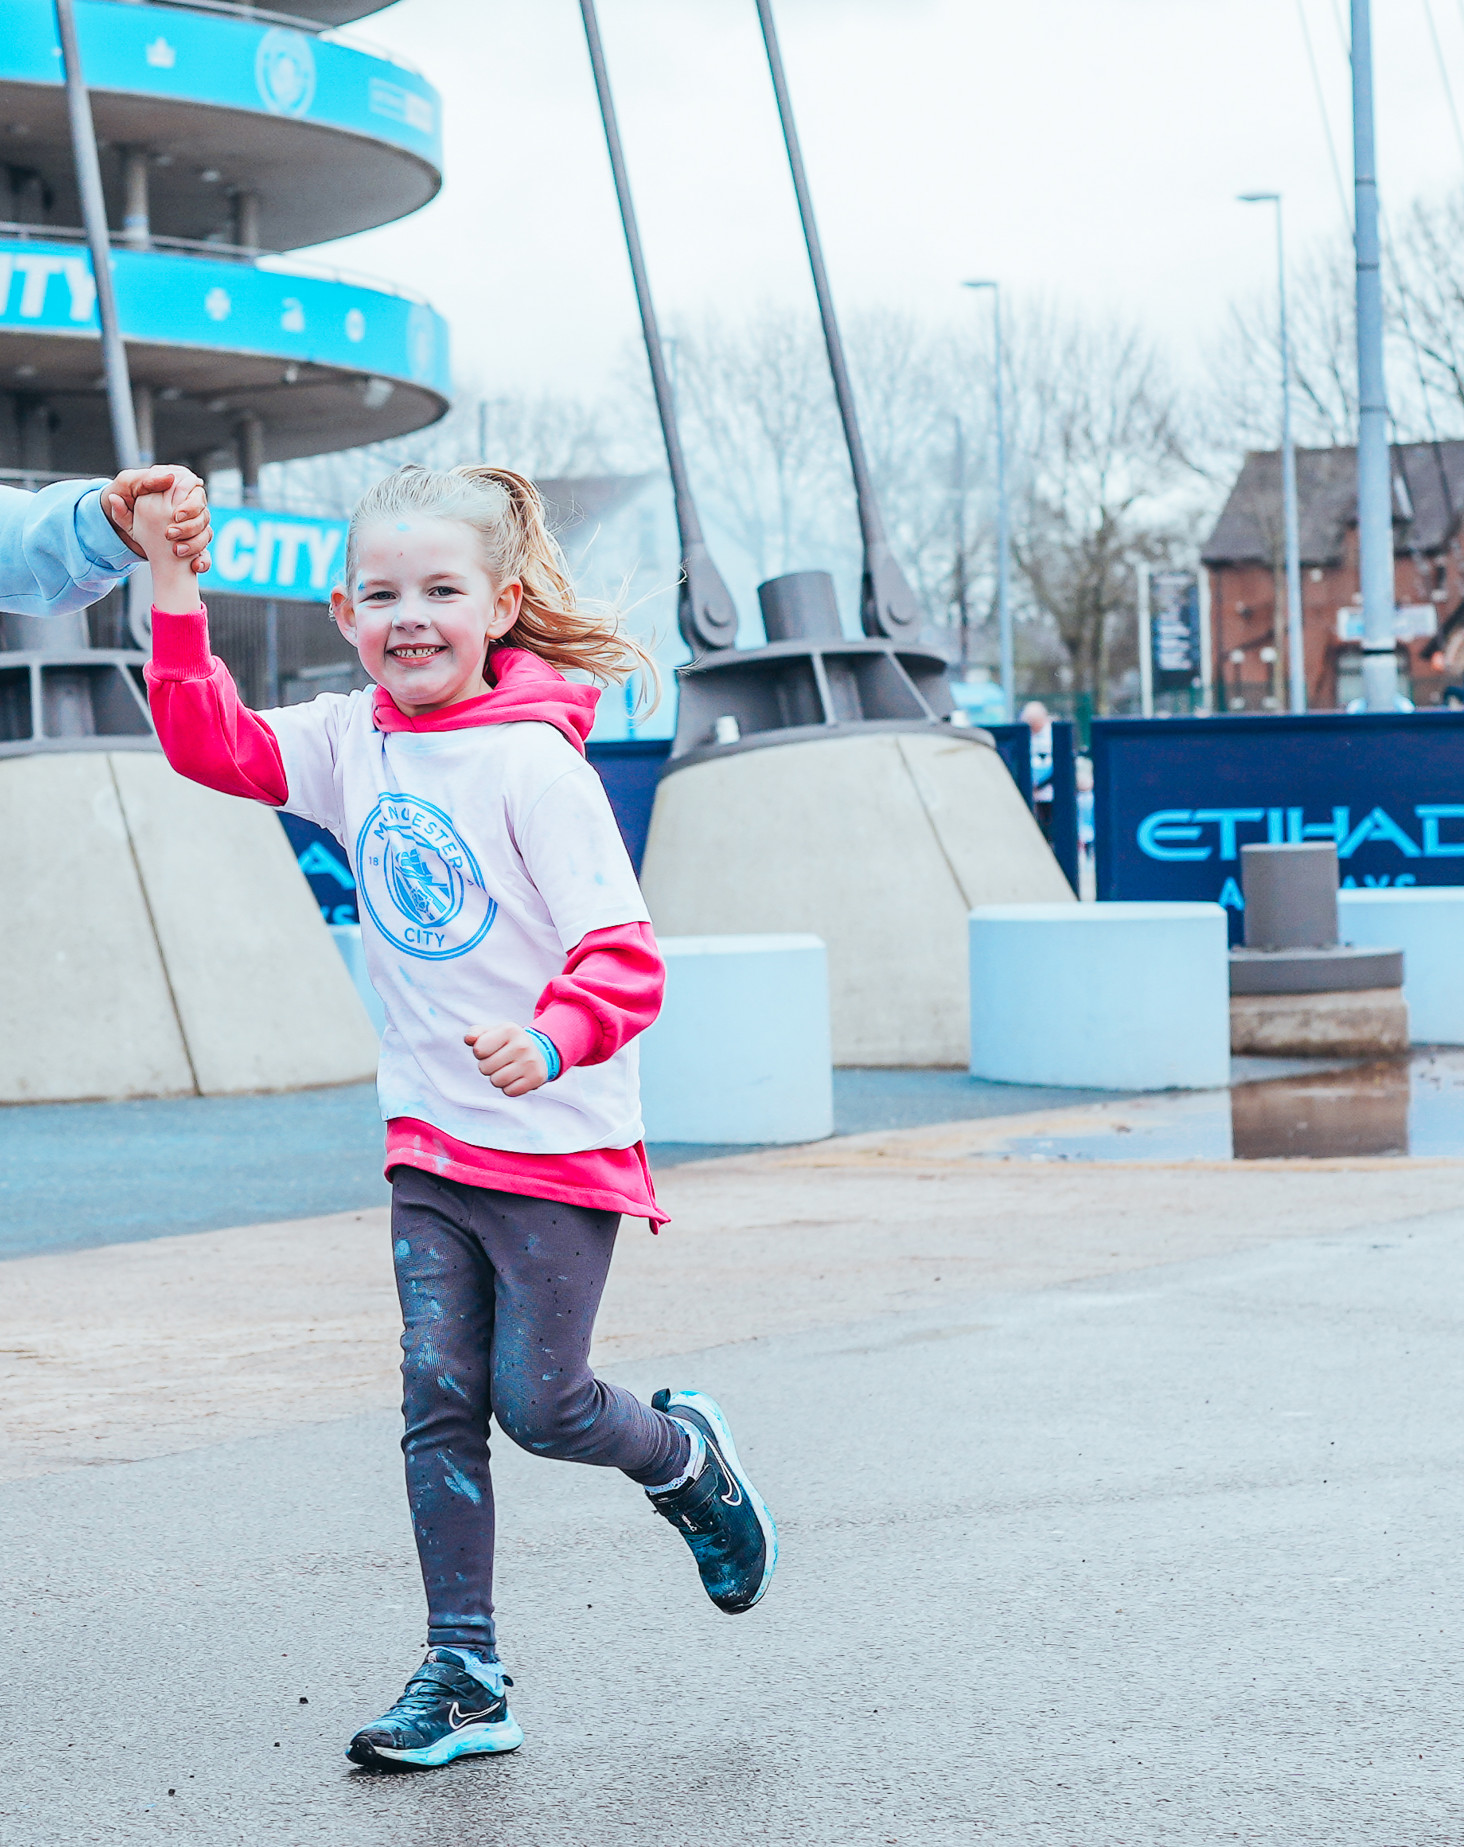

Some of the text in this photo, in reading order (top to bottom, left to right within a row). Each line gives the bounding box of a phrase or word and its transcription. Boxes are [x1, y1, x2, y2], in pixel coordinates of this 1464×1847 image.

[216, 518, 342, 590] CITY
[368, 856, 379, 866] 18
[404, 927, 445, 948] CITY
